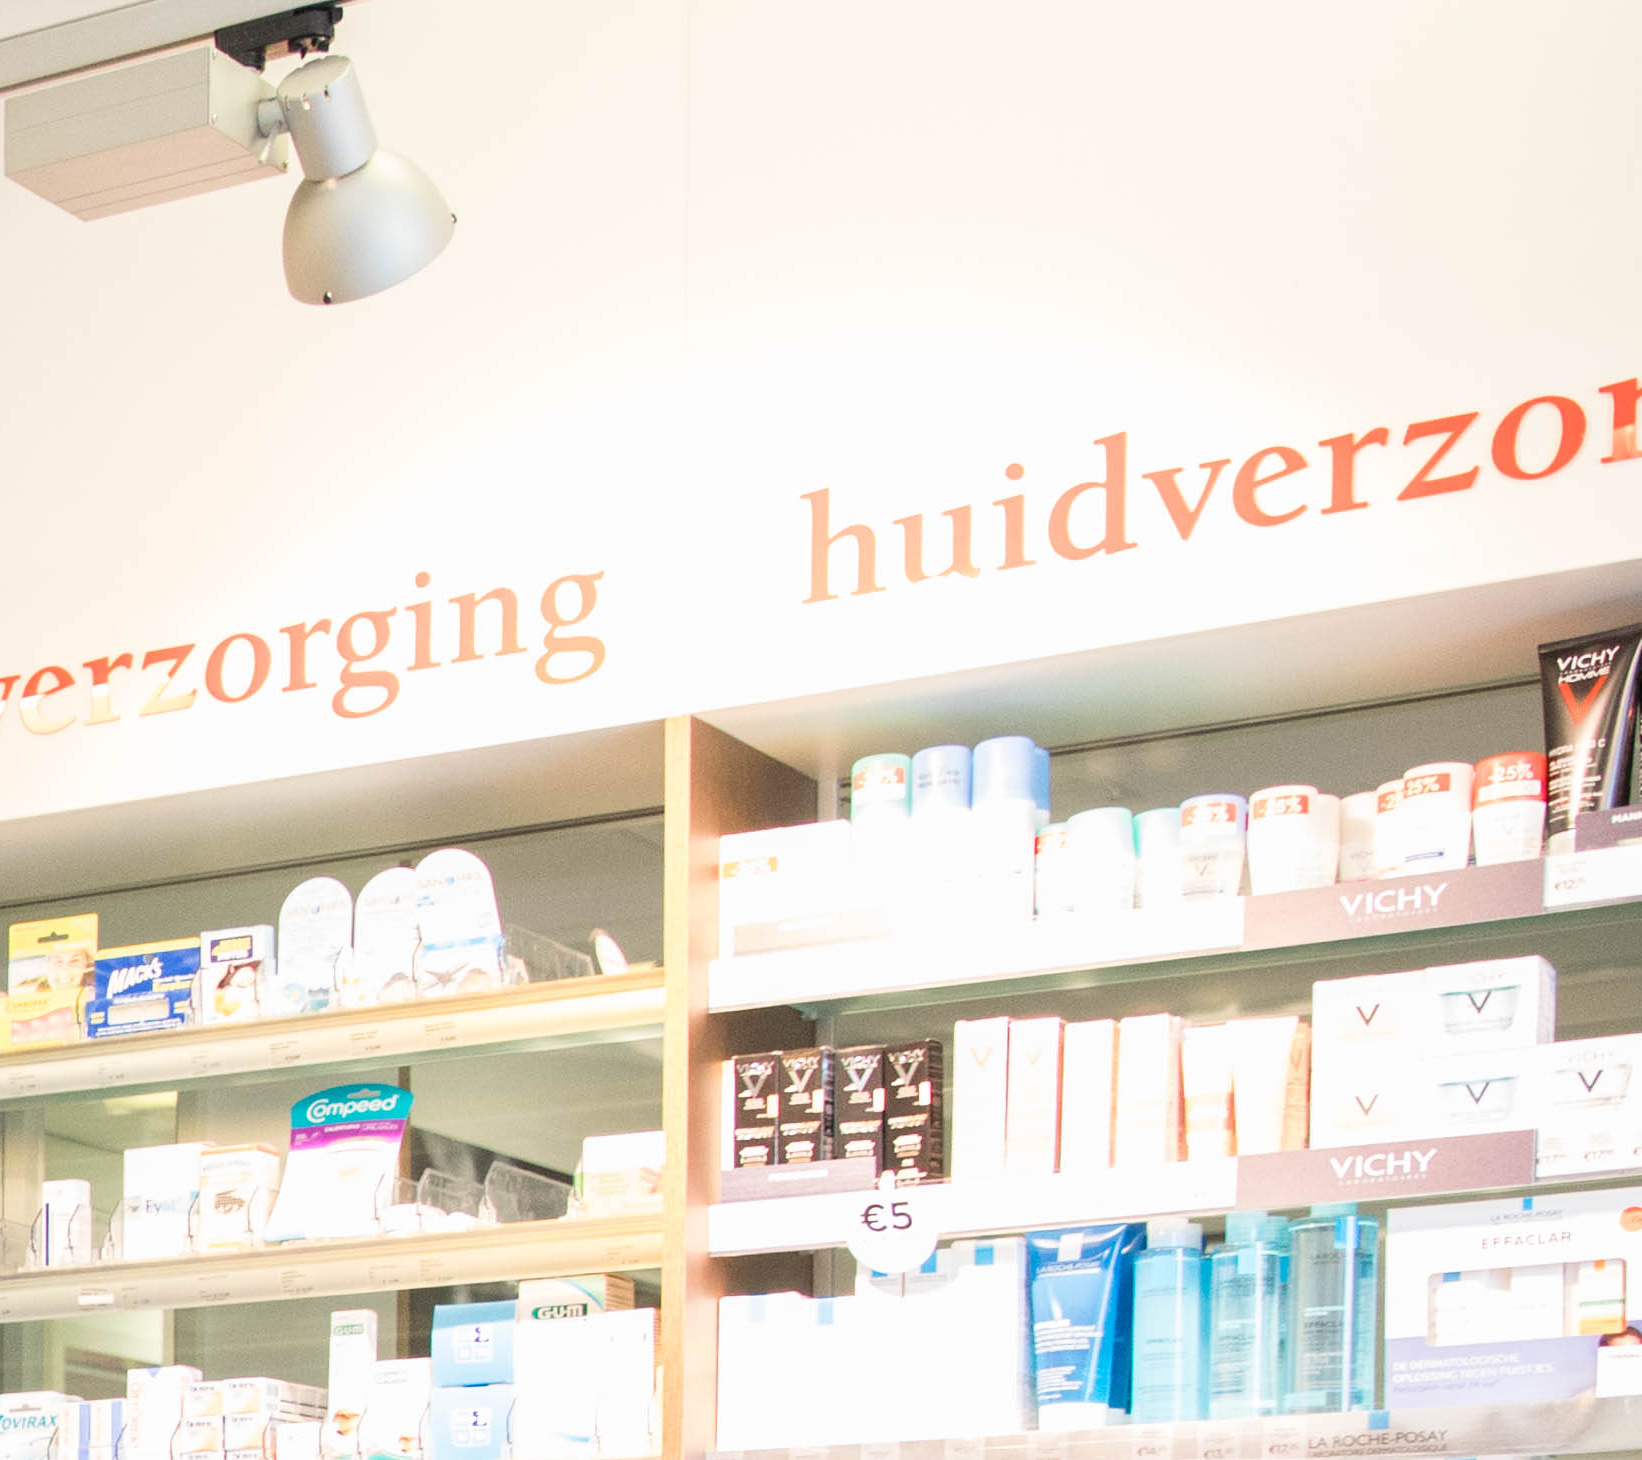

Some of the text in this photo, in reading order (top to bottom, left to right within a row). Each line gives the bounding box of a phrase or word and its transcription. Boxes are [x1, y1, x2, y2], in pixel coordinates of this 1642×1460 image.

[1557, 646, 1619, 670] VICHY
[1558, 666, 1610, 684] HOMME
[1340, 883, 1448, 916] VICHY
[306, 1093, 399, 1124] Compeed
[1330, 1148, 1437, 1179] VICHY
[860, 1201, 913, 1233] €5
[1481, 1231, 1572, 1249] EFFACLAR
[1307, 1429, 1449, 1450] LA ROCHE-POSAY
